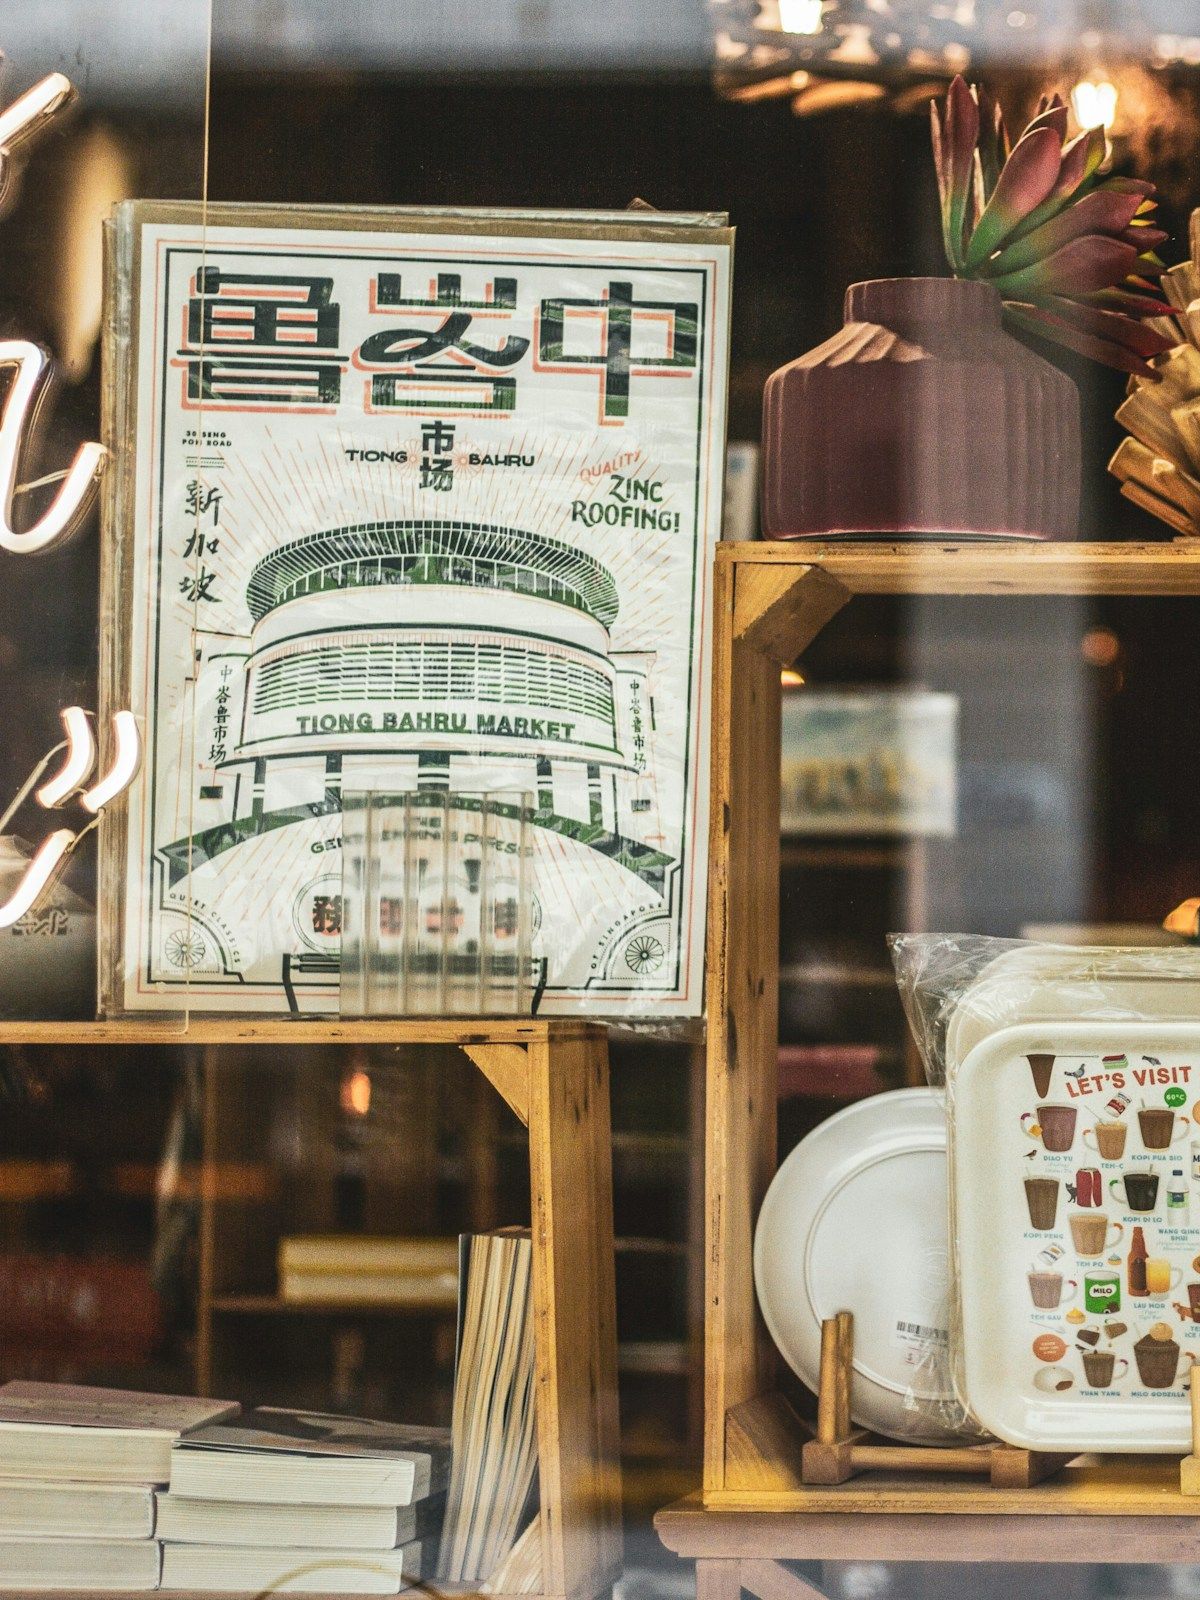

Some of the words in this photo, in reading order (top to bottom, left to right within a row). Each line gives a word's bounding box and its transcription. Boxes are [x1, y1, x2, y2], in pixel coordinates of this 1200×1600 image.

[345, 449, 408, 463] TIONG
[419, 421, 456, 492] 市场
[468, 453, 535, 467] BAHRU
[580, 450, 642, 485] QUALITY
[609, 474, 663, 503] ZINC
[571, 500, 680, 533] ROOFING!
[179, 481, 223, 602] 新加坡
[209, 665, 233, 763] 中峇鲁市场
[296, 713, 373, 734] TIONG
[383, 712, 467, 732] BAHRU
[476, 714, 576, 740] MARKET
[211, 911, 241, 963] CLASSICS
[591, 954, 598, 969] OF
[598, 902, 661, 946] SINGAPORE
[1066, 1072, 1126, 1098] LET'S
[1132, 1066, 1192, 1086] VISIT
